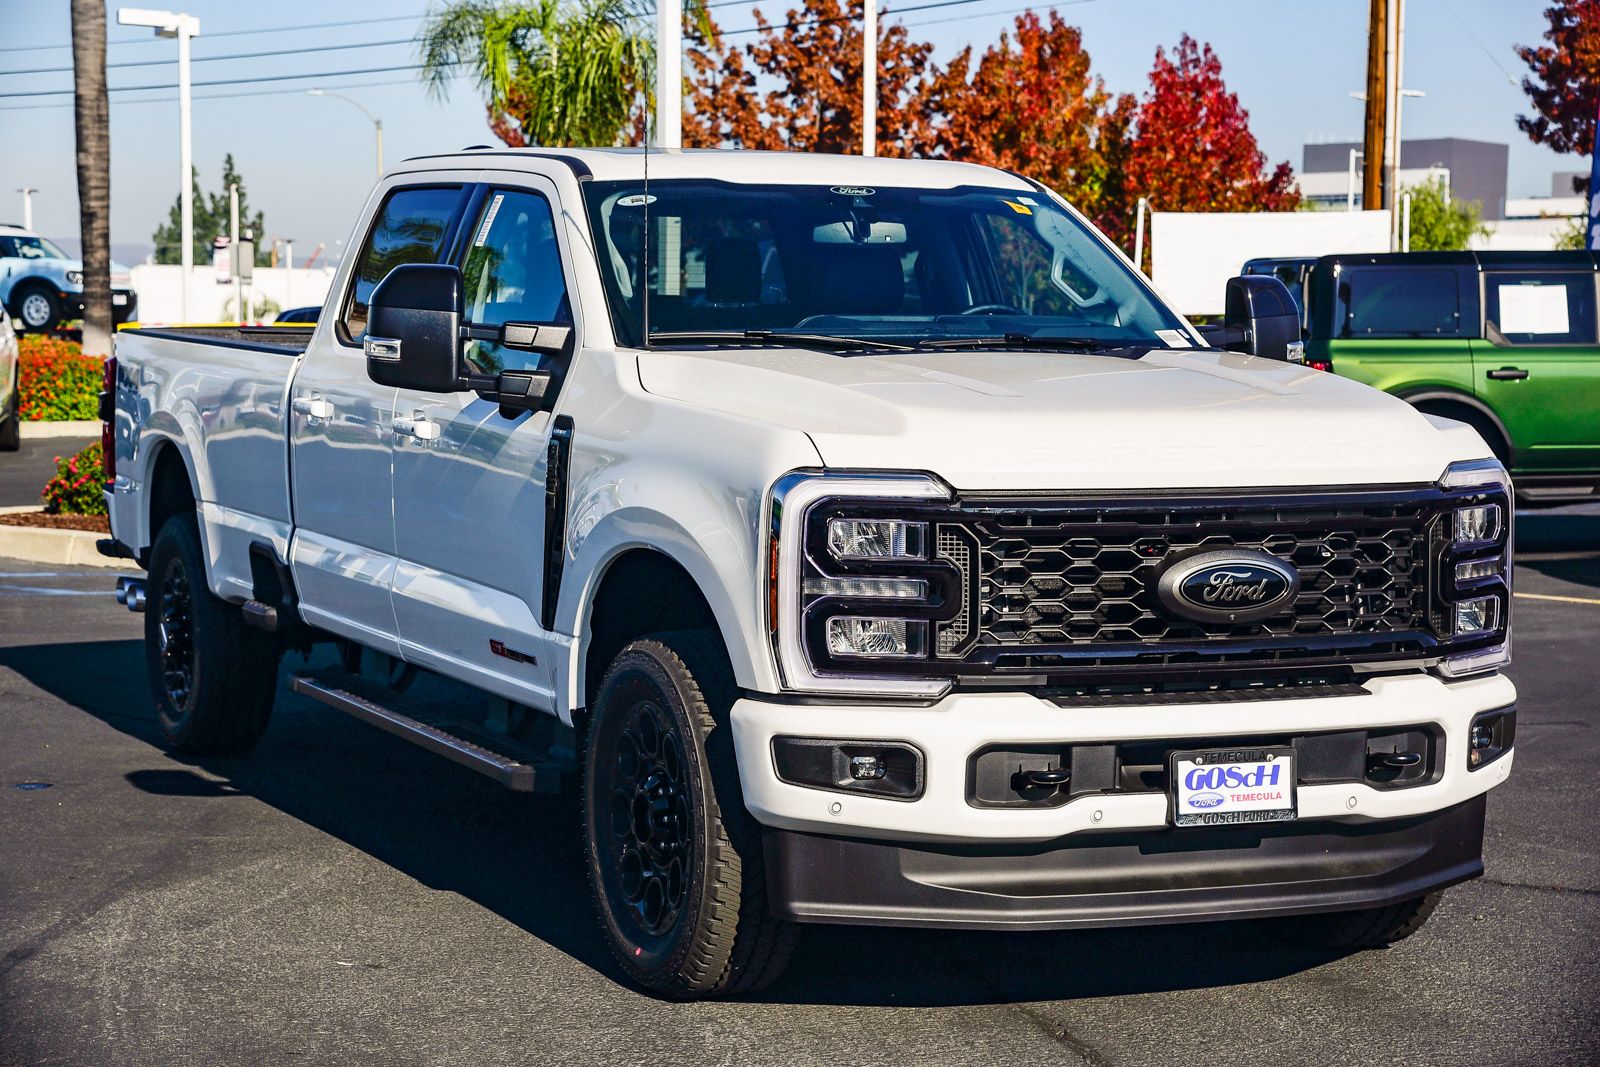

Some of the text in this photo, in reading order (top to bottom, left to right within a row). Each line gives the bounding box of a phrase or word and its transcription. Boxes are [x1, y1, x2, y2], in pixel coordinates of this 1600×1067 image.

[1016, 439, 1384, 463] SUPER DUTY
[1202, 571, 1268, 601] Ford
[1203, 751, 1266, 763] TEMECULA
[1194, 797, 1219, 807] Ford
[1230, 792, 1282, 802] TEMECULA
